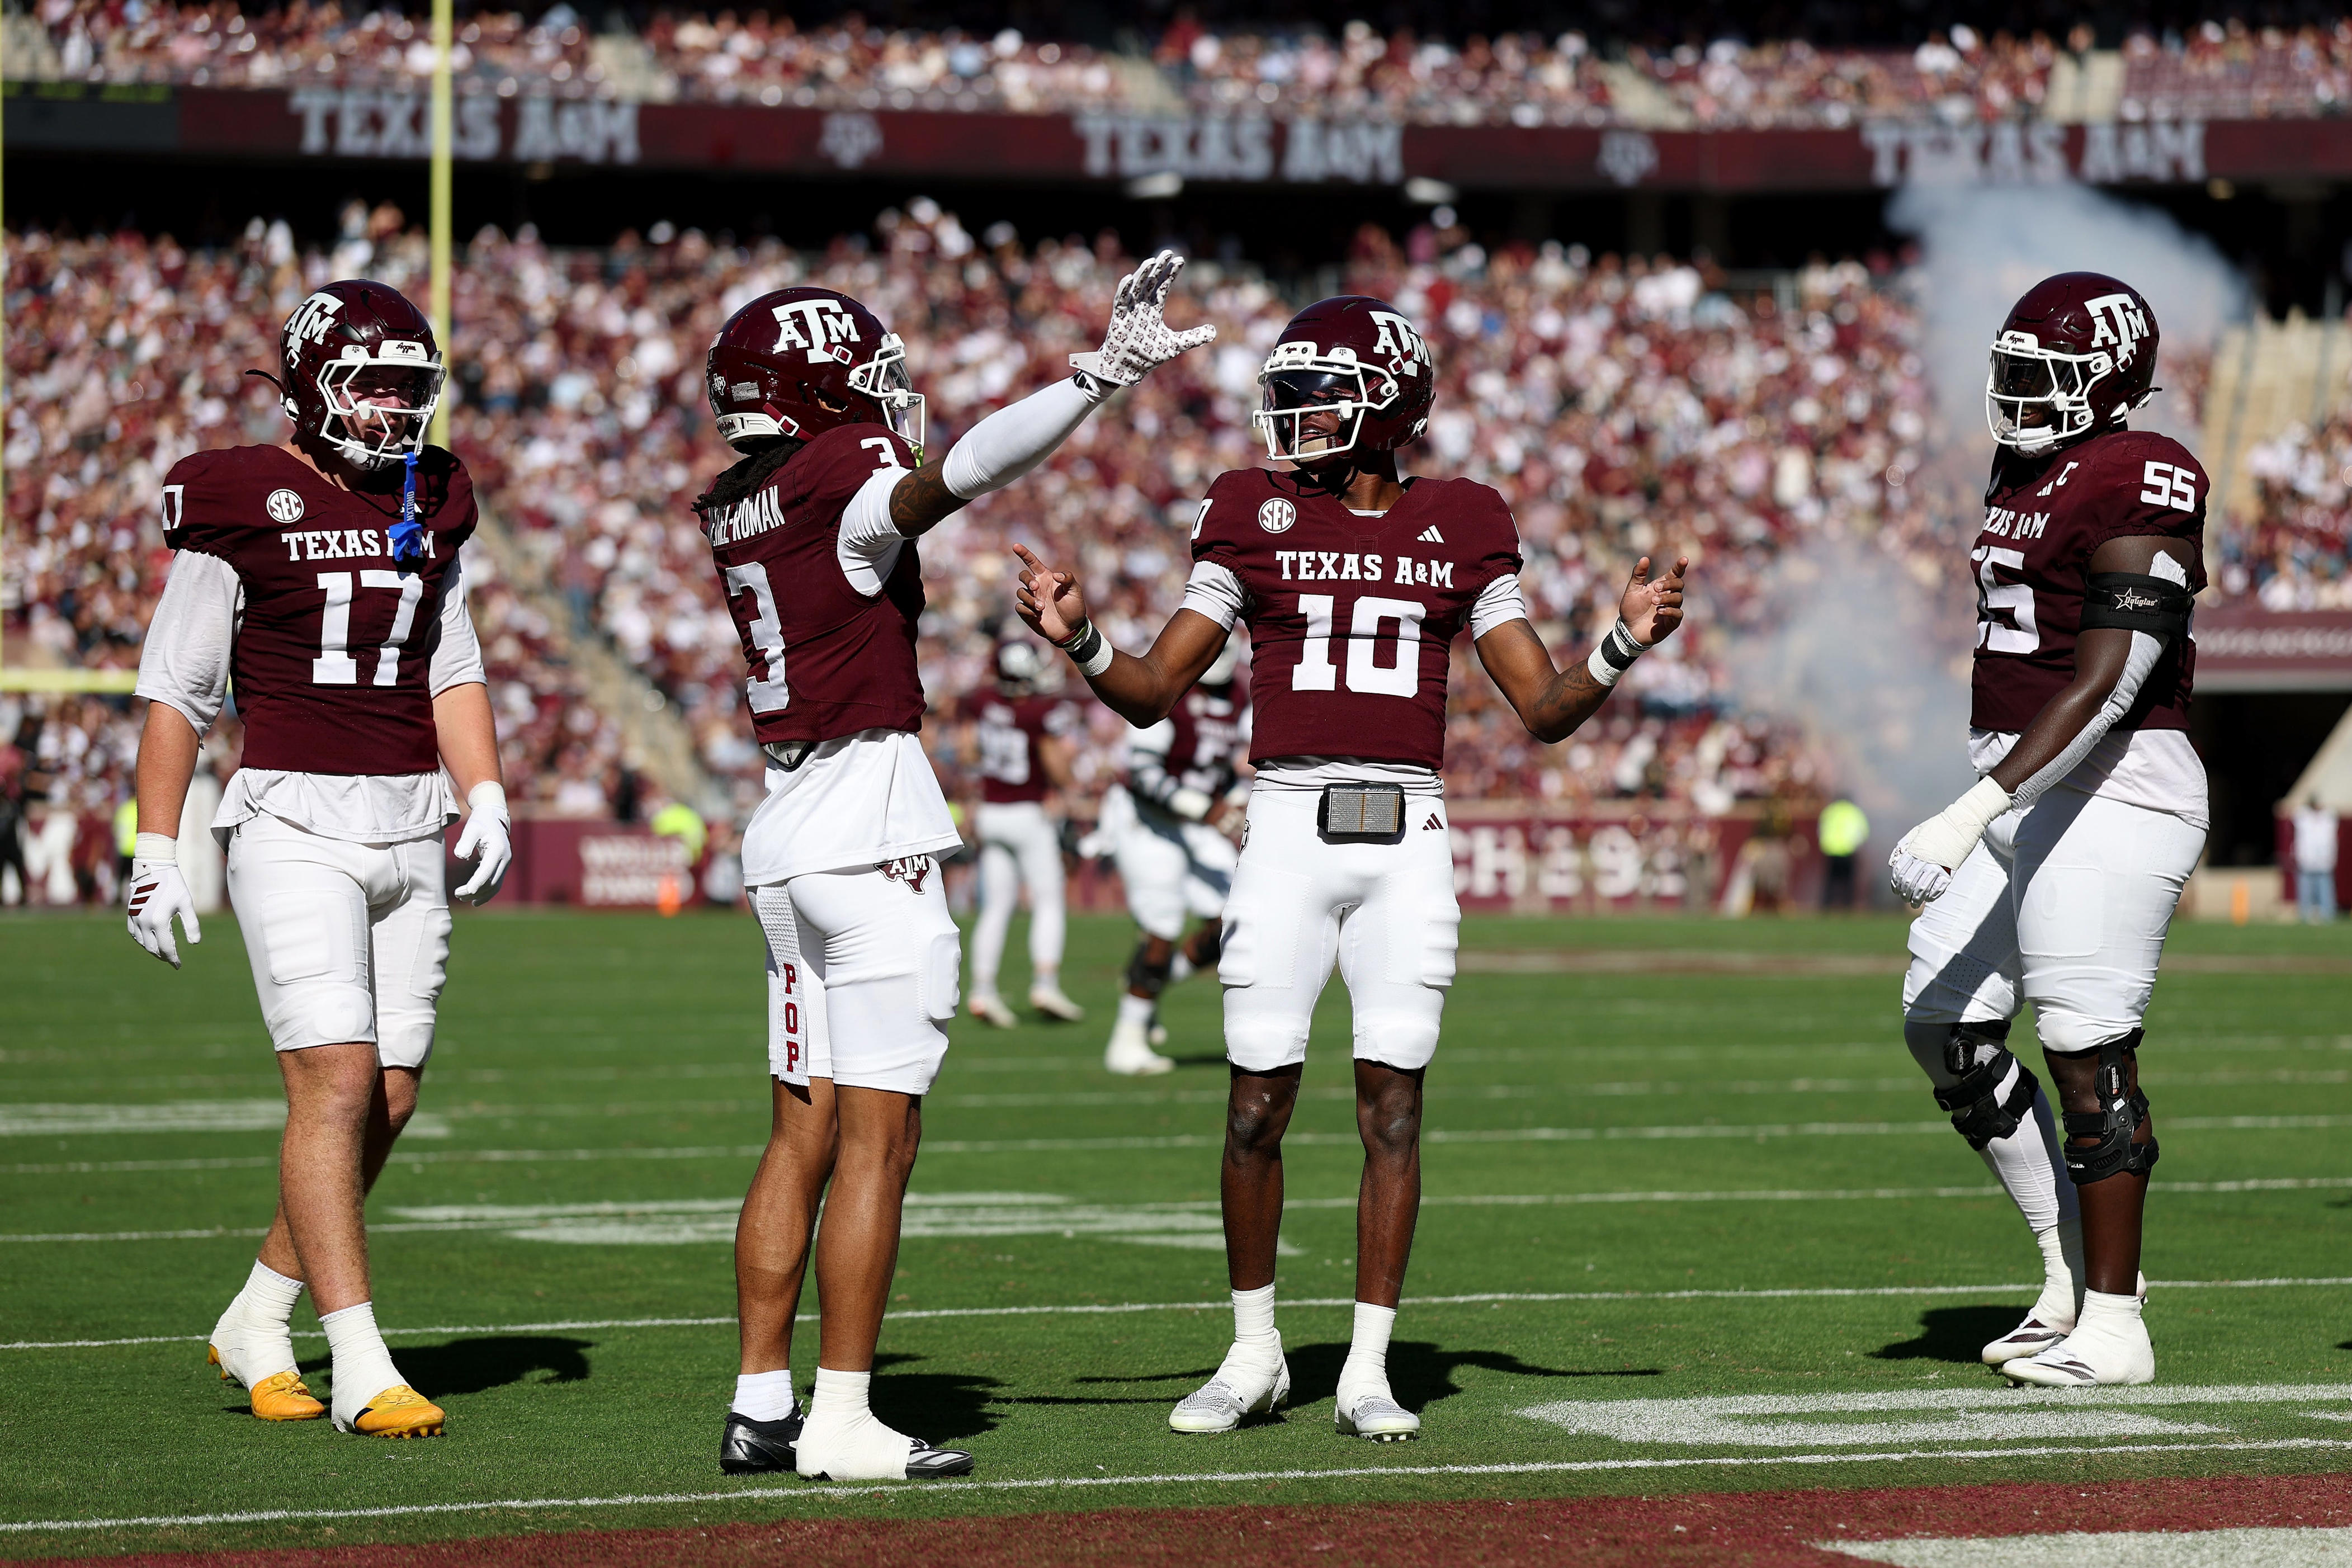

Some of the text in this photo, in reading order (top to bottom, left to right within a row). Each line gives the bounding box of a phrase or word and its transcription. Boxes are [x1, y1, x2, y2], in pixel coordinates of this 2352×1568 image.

[1073, 116, 1273, 180] TEXAS
[2056, 461, 2079, 486] C
[2141, 461, 2196, 513] 55
[268, 490, 302, 521] SEC
[1261, 500, 1293, 531] SEC
[2011, 512, 2051, 540] A&M
[281, 529, 381, 561] TEXAS
[1276, 551, 1454, 588] TEXAS A&M
[313, 569, 423, 686] 17
[726, 561, 790, 714] 3
[1292, 594, 1427, 698] 10
